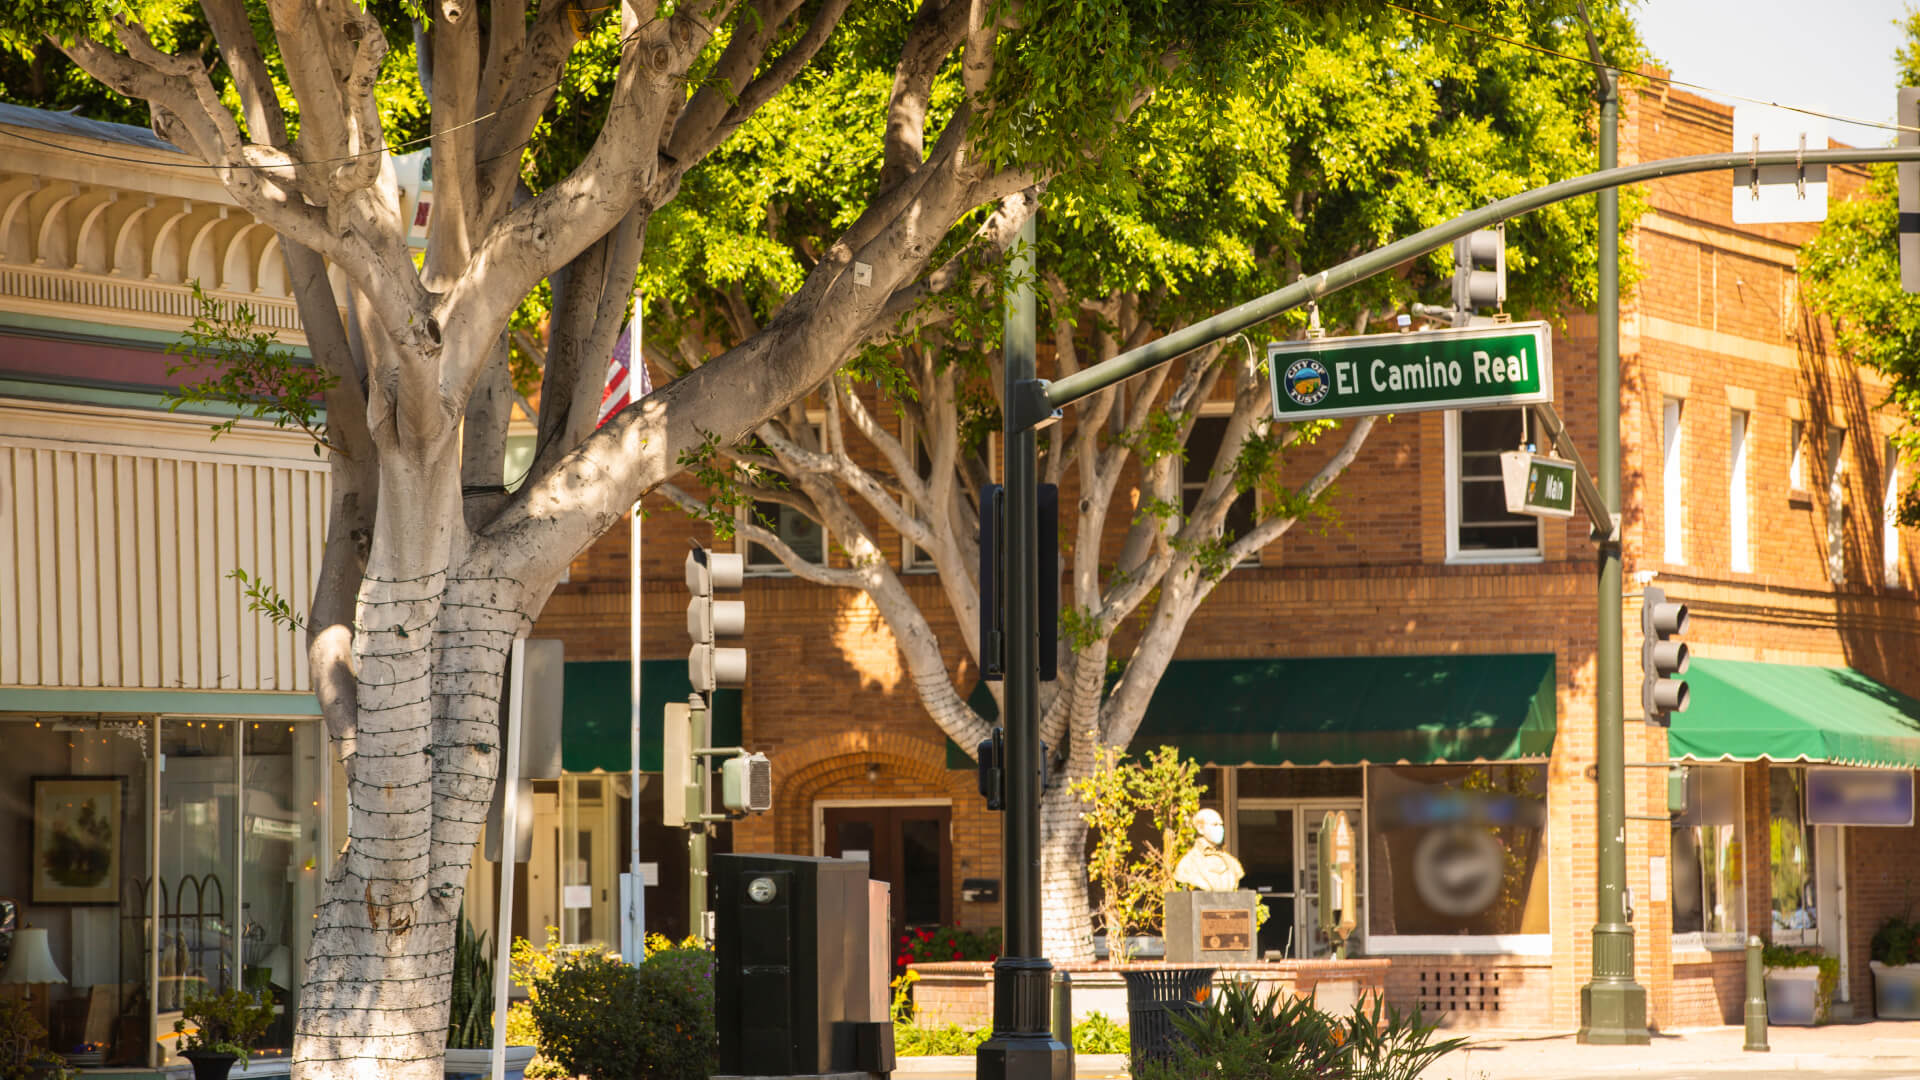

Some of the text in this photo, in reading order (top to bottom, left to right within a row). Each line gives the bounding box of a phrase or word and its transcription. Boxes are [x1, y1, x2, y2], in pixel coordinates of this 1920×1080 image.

[1288, 360, 1326, 378] CITY OF
[1335, 347, 1529, 395] El Camino Real
[1290, 385, 1329, 403] TUSTIN
[1545, 474, 1564, 501] Main
